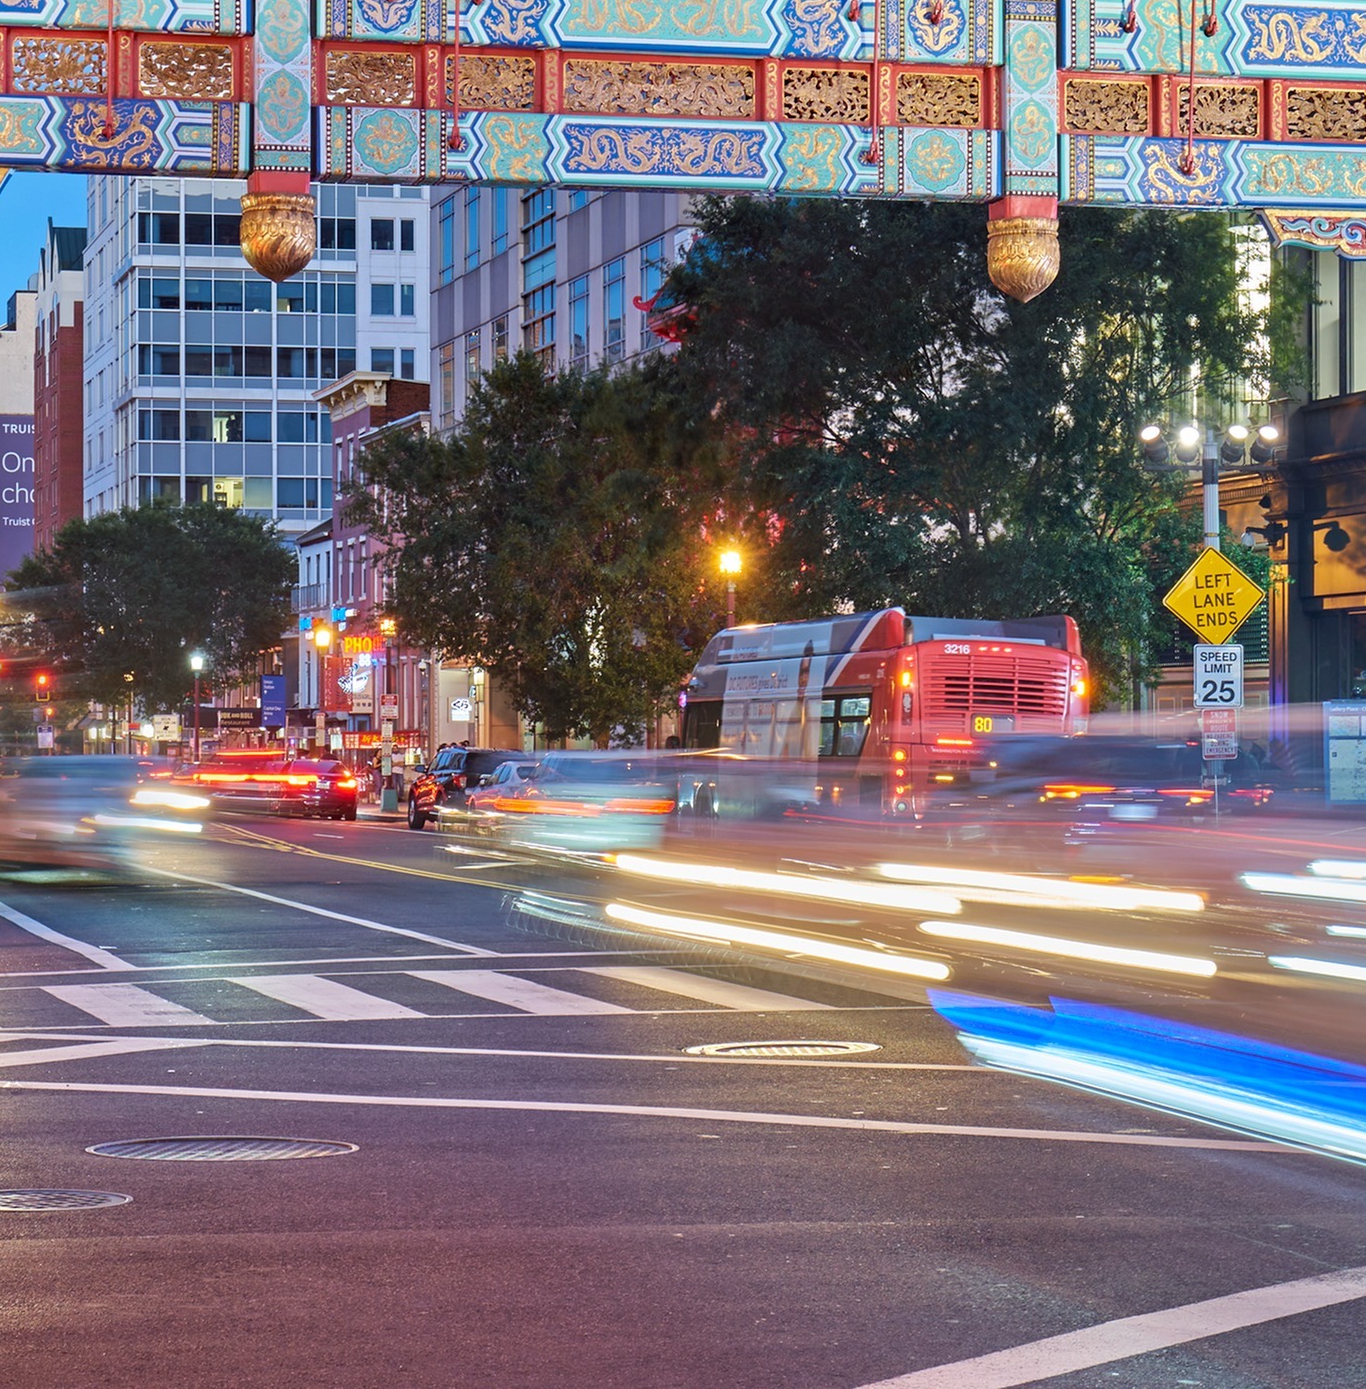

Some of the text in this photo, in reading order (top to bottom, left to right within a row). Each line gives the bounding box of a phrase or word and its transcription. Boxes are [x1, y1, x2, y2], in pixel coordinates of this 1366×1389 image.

[2, 516, 31, 527] Truist
[1195, 573, 1232, 589] LEFT
[1193, 592, 1236, 609] LANE
[1196, 611, 1238, 628] ENDS
[344, 637, 372, 653] PHO
[944, 643, 971, 655] 3216
[1199, 651, 1237, 662] SPEED
[1204, 663, 1233, 673] LIMIT
[1202, 679, 1235, 703] 25
[1210, 711, 1229, 719] SNOW
[974, 716, 993, 733] 80
